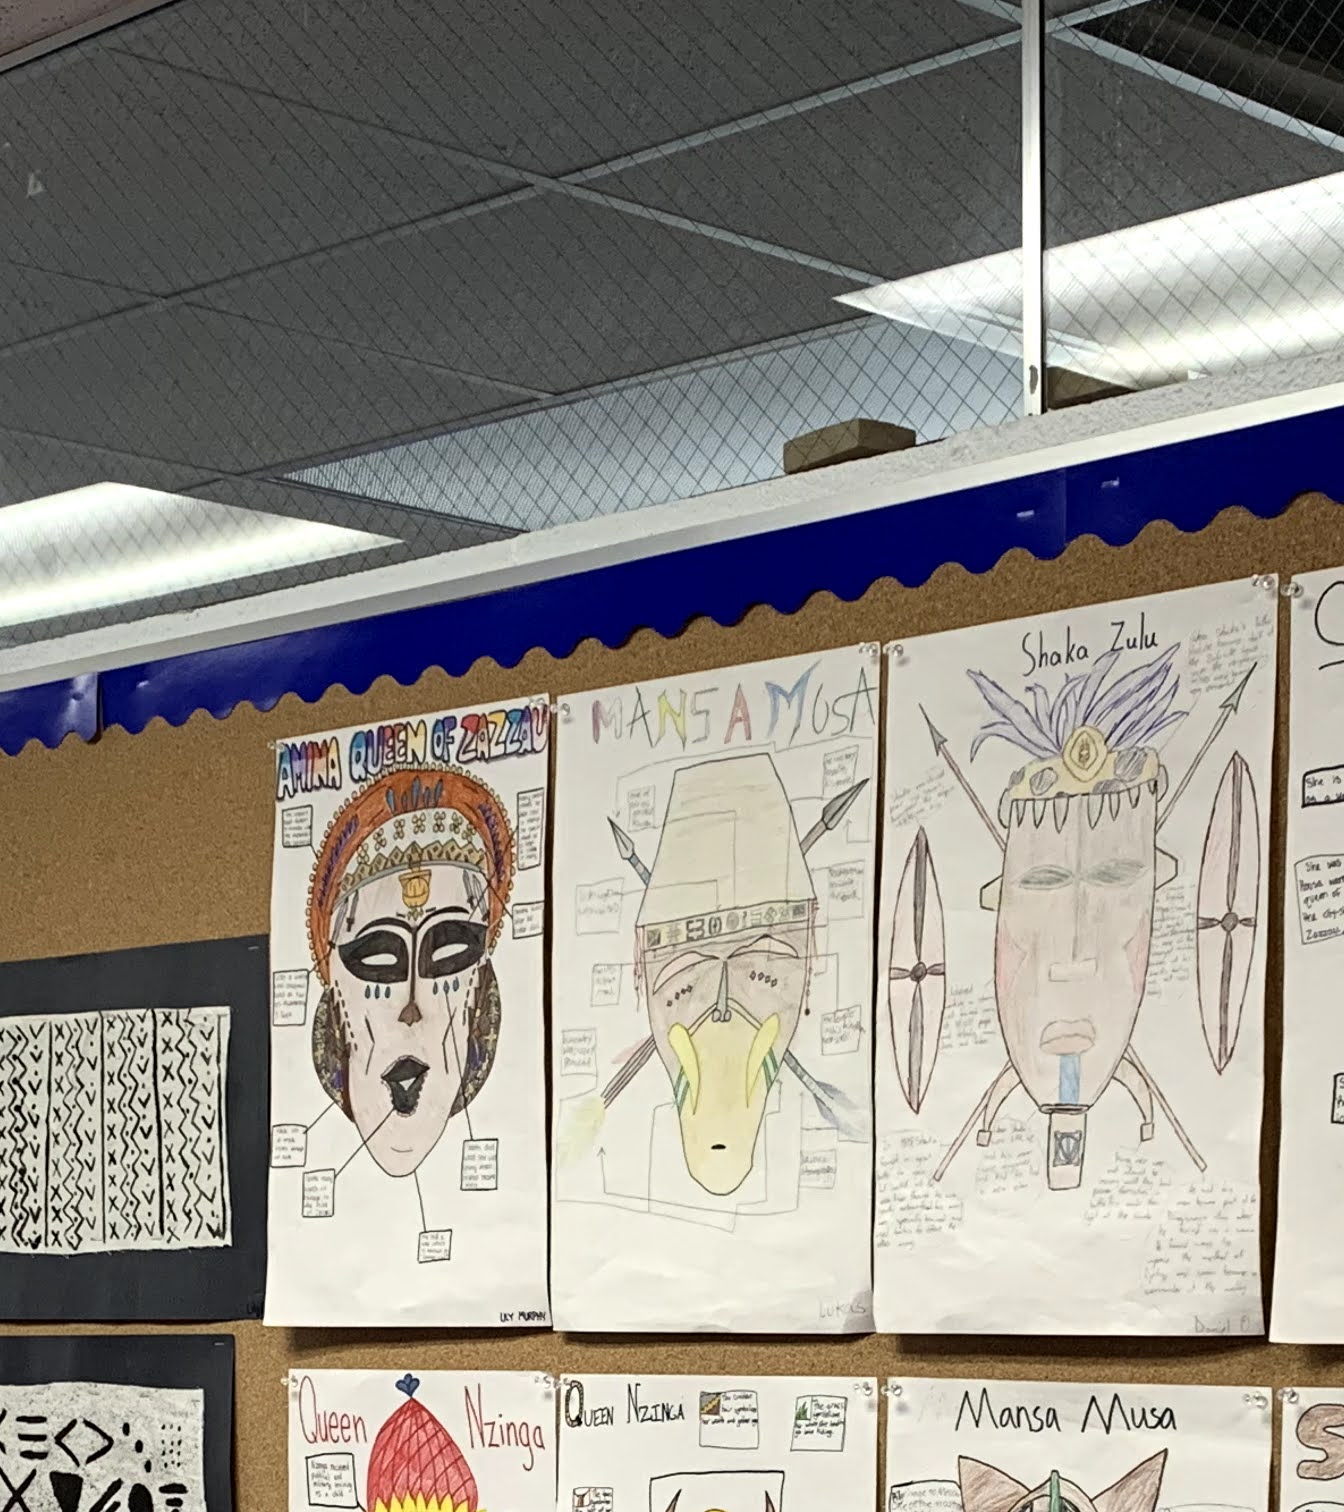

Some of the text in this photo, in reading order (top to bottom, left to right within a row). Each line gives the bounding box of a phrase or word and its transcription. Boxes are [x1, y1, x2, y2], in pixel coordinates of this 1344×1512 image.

[1021, 612, 1160, 678] Shaka Zulu
[765, 659, 878, 746] MUSA
[276, 703, 550, 800] AMINA QUEEN OF ZAZZAU
[299, 1375, 545, 1471] Queen Nzinga
[565, 1380, 614, 1427] QUEEN
[626, 1383, 685, 1424] NZINGA
[955, 1388, 1177, 1435] Mansa Musa
